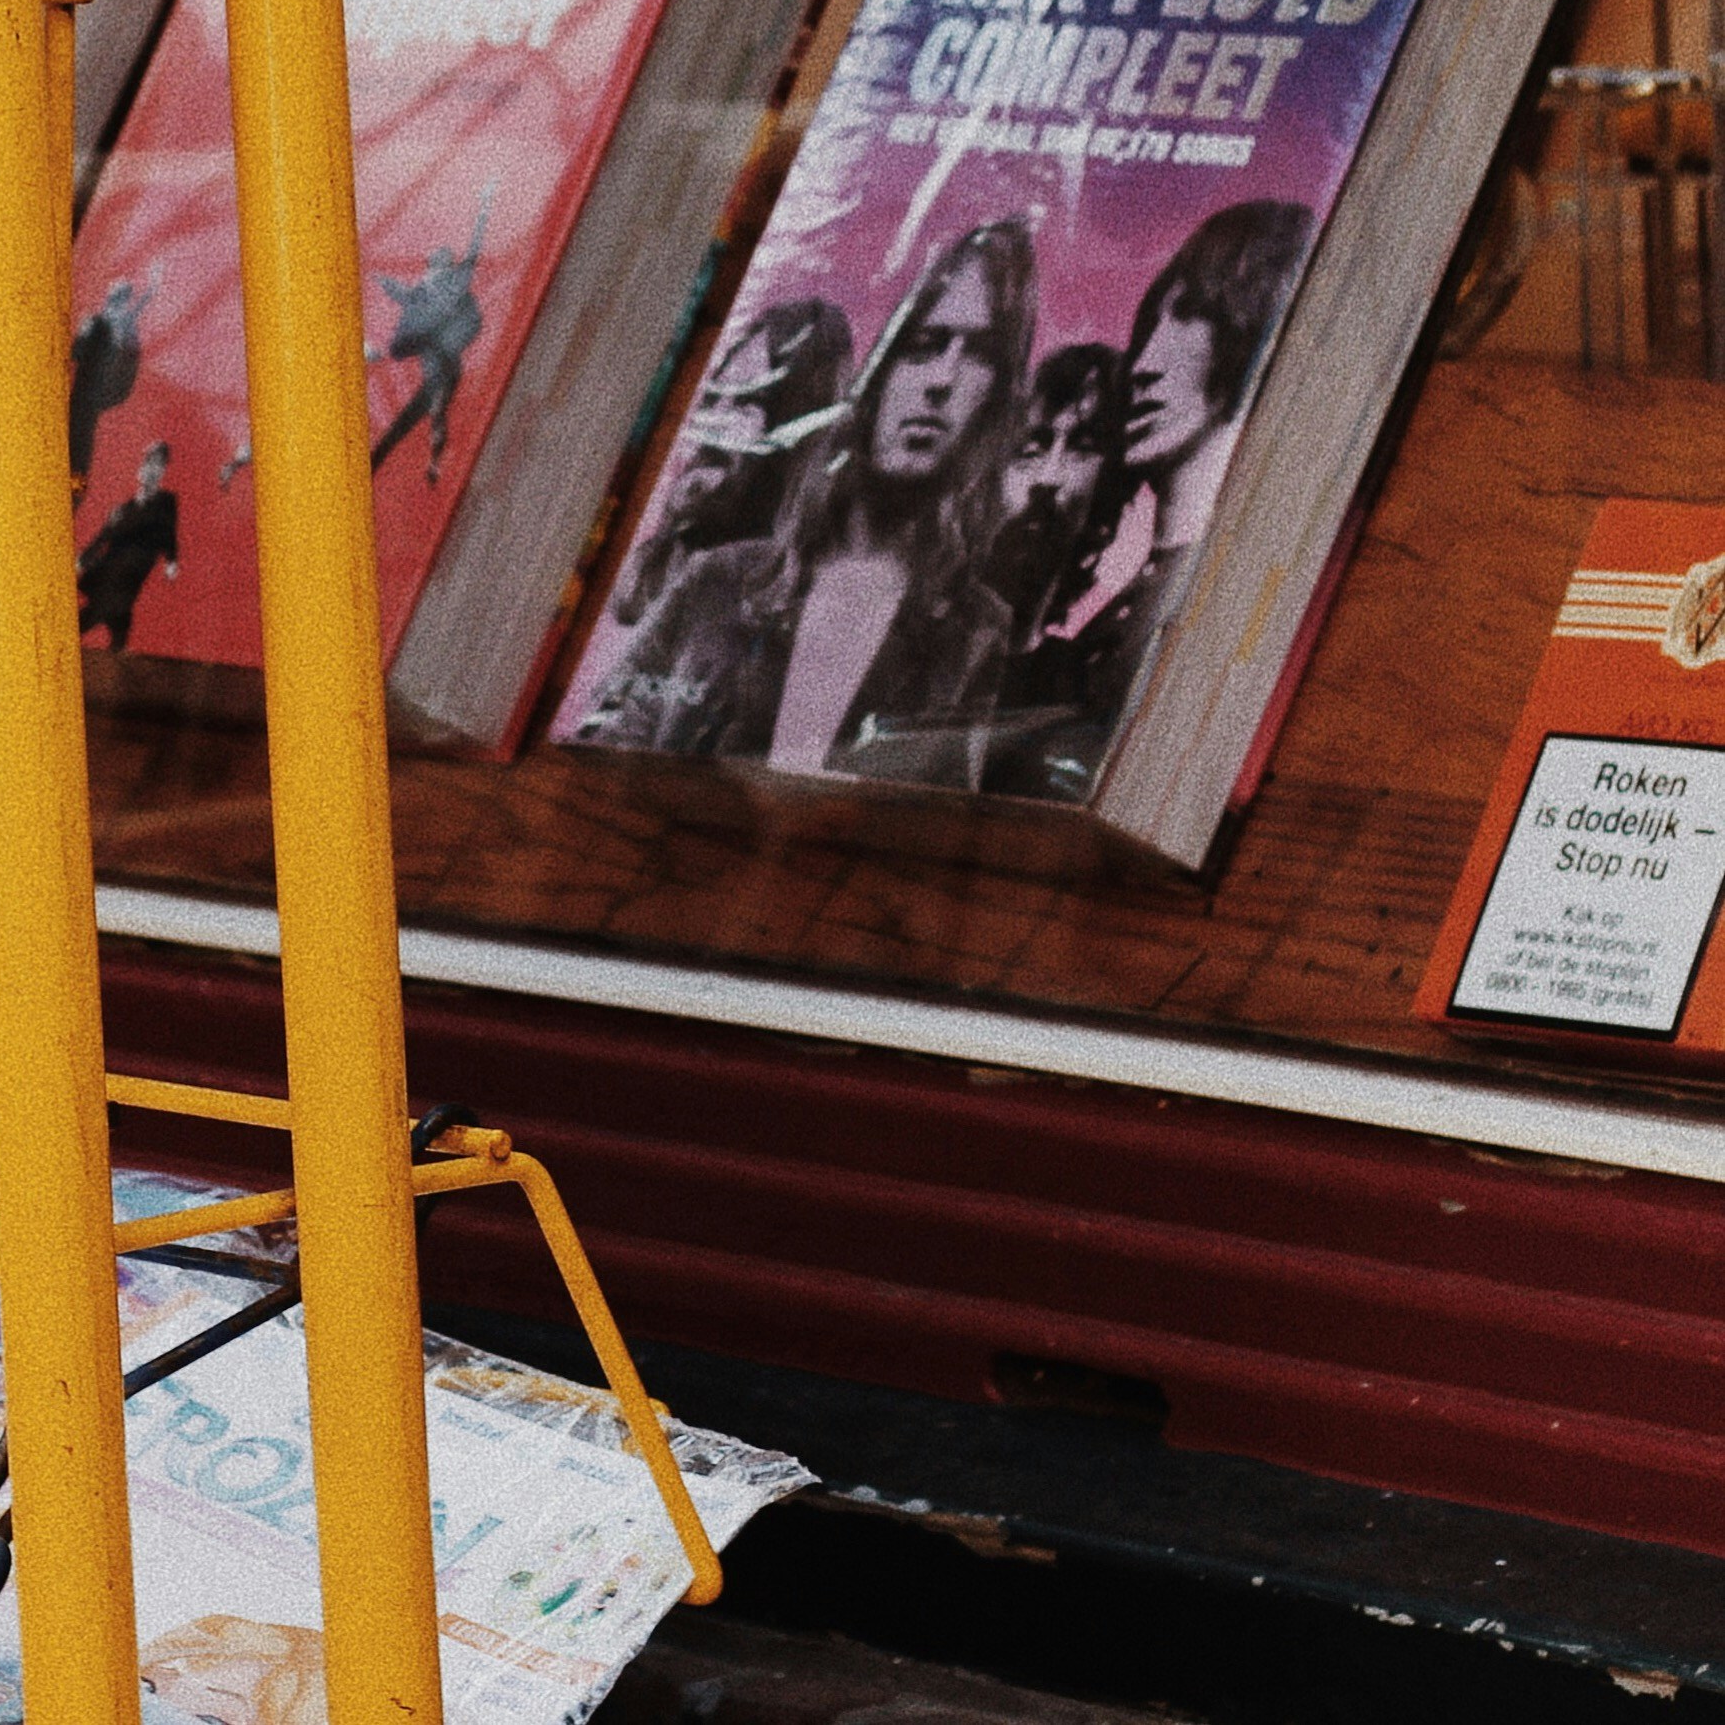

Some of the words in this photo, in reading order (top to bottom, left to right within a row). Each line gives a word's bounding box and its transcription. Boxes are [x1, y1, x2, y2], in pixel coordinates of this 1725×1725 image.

[909, 17, 1303, 120] COMPLEET
[1592, 762, 1688, 799] Roken
[1533, 805, 1559, 828] is
[1566, 802, 1680, 846] dodelijk
[1554, 841, 1623, 880] Stop
[1629, 854, 1669, 882] nu
